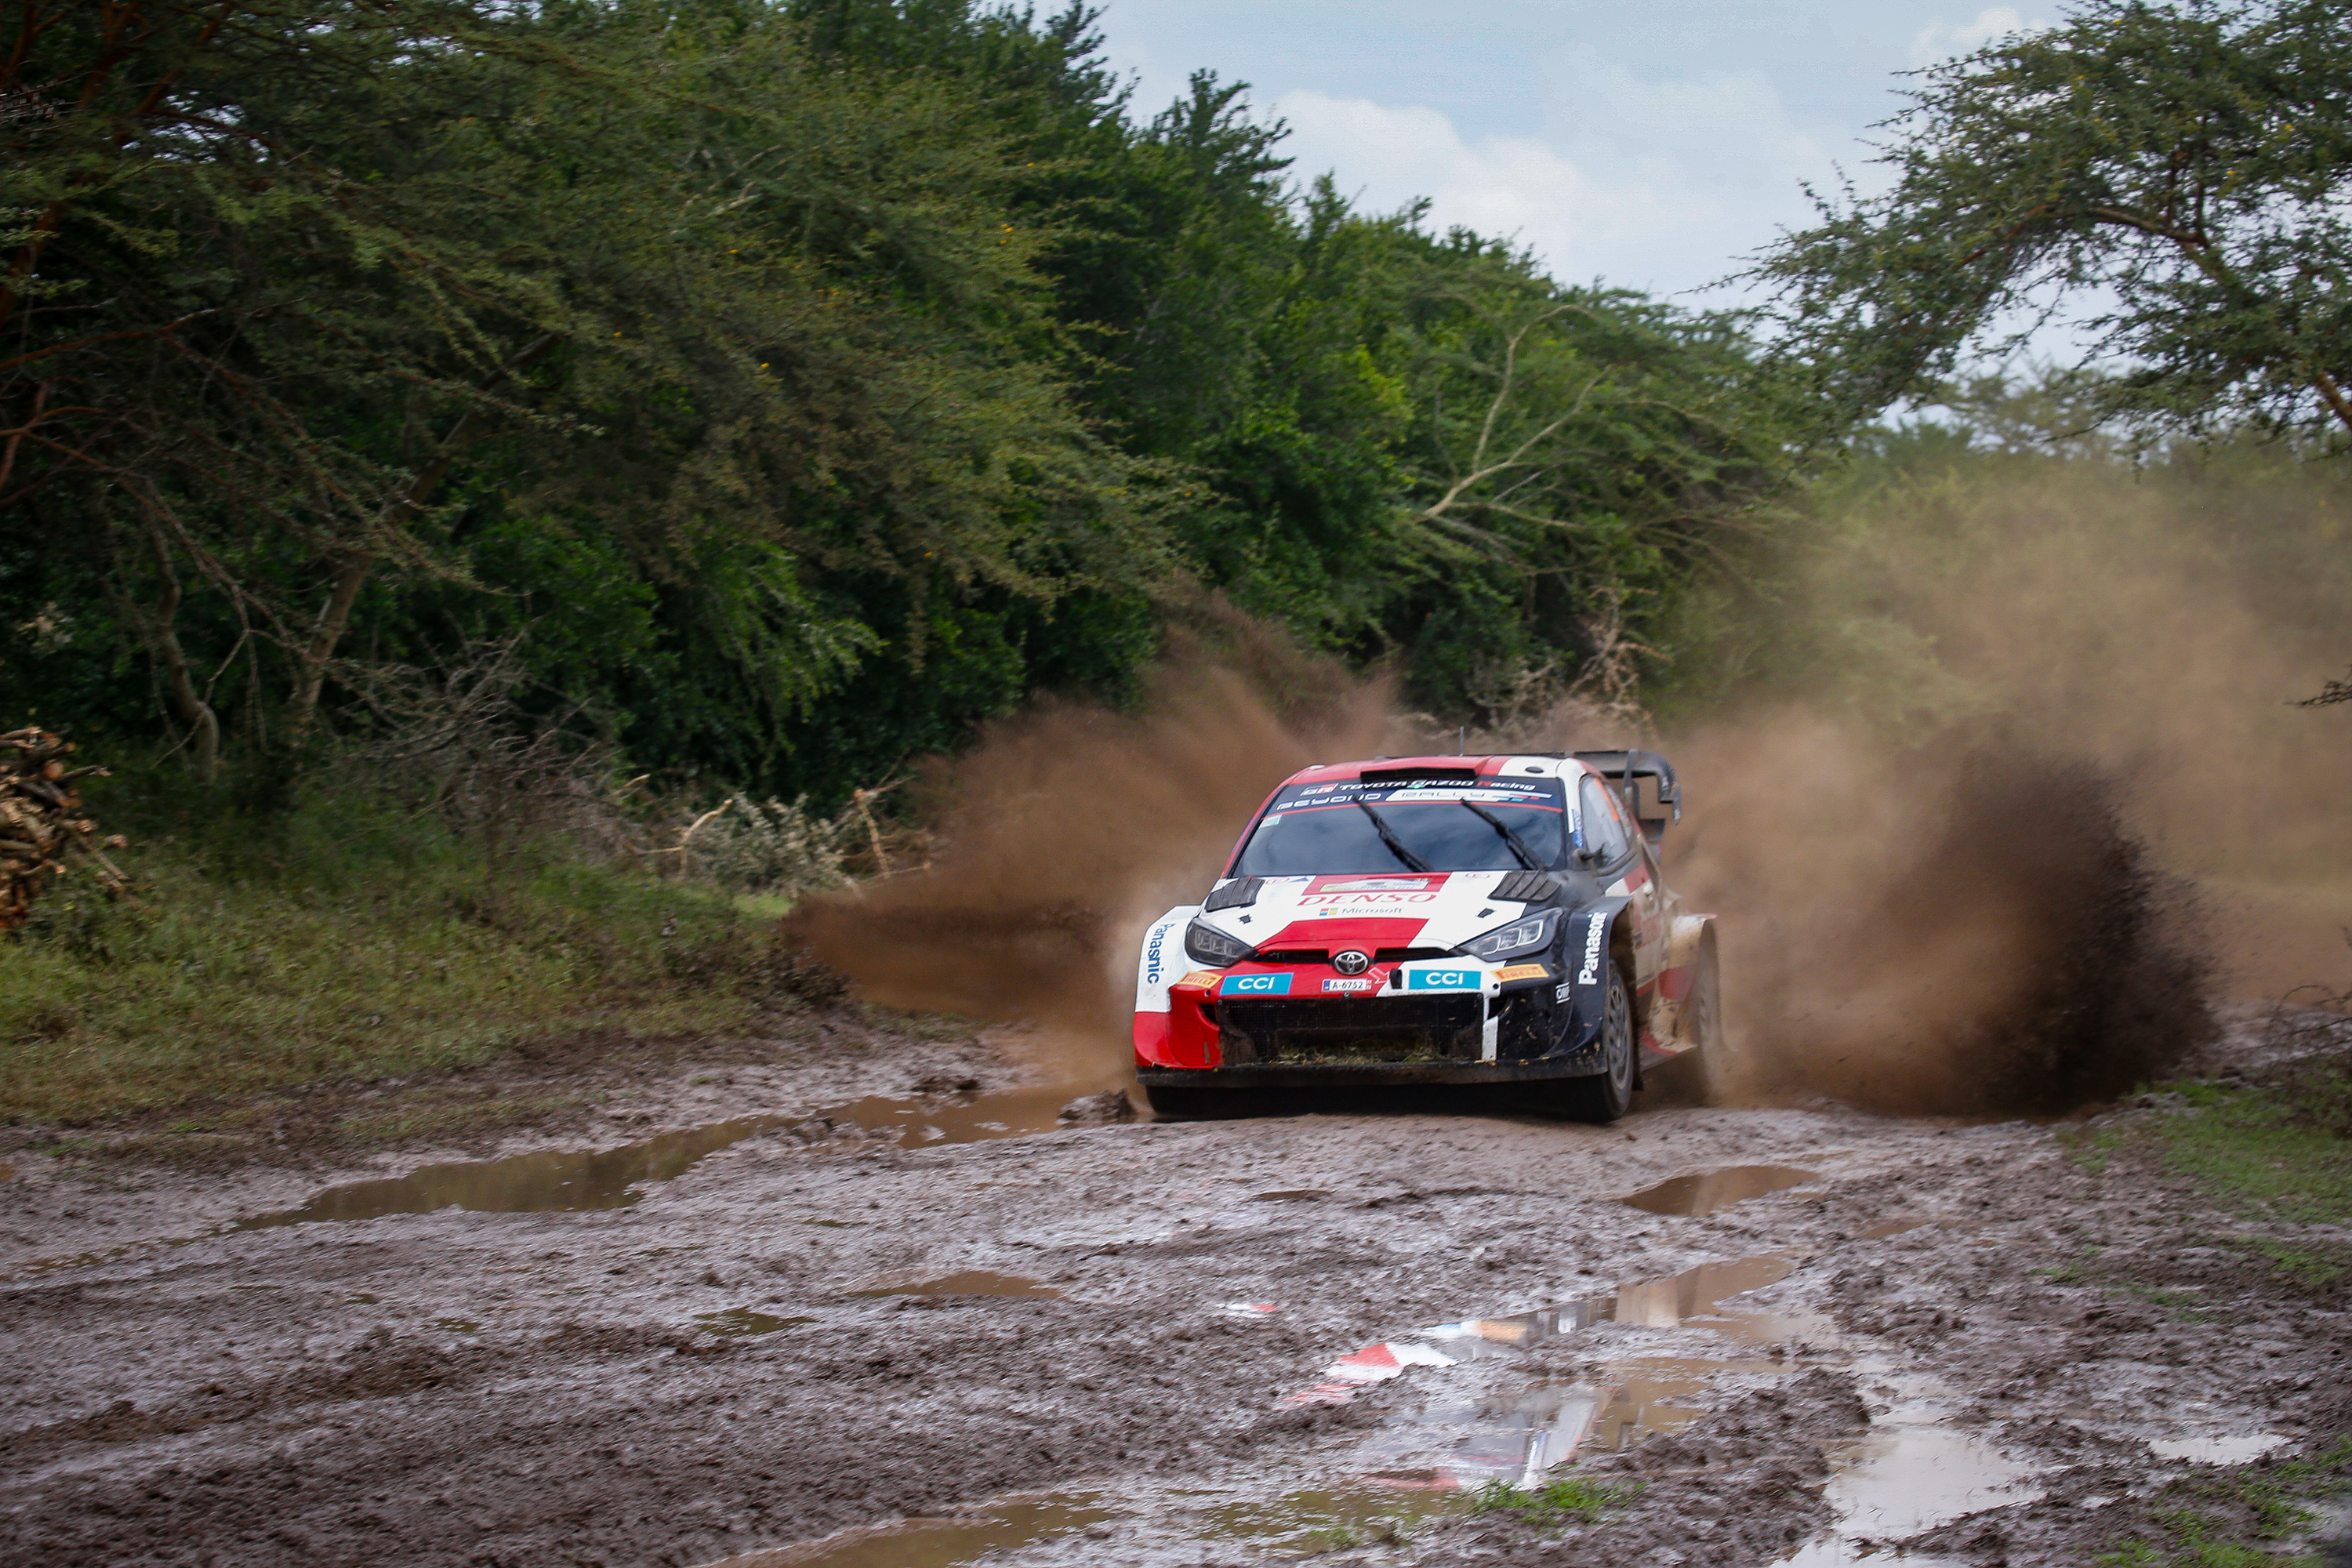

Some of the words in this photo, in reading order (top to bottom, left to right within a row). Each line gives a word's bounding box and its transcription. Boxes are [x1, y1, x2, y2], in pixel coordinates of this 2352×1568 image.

[1340, 780, 1407, 791] TOYOTA
[1276, 793, 1381, 811] BEYOND
[1296, 894, 1437, 906] DENSO
[1332, 981, 1363, 989] A-6752
